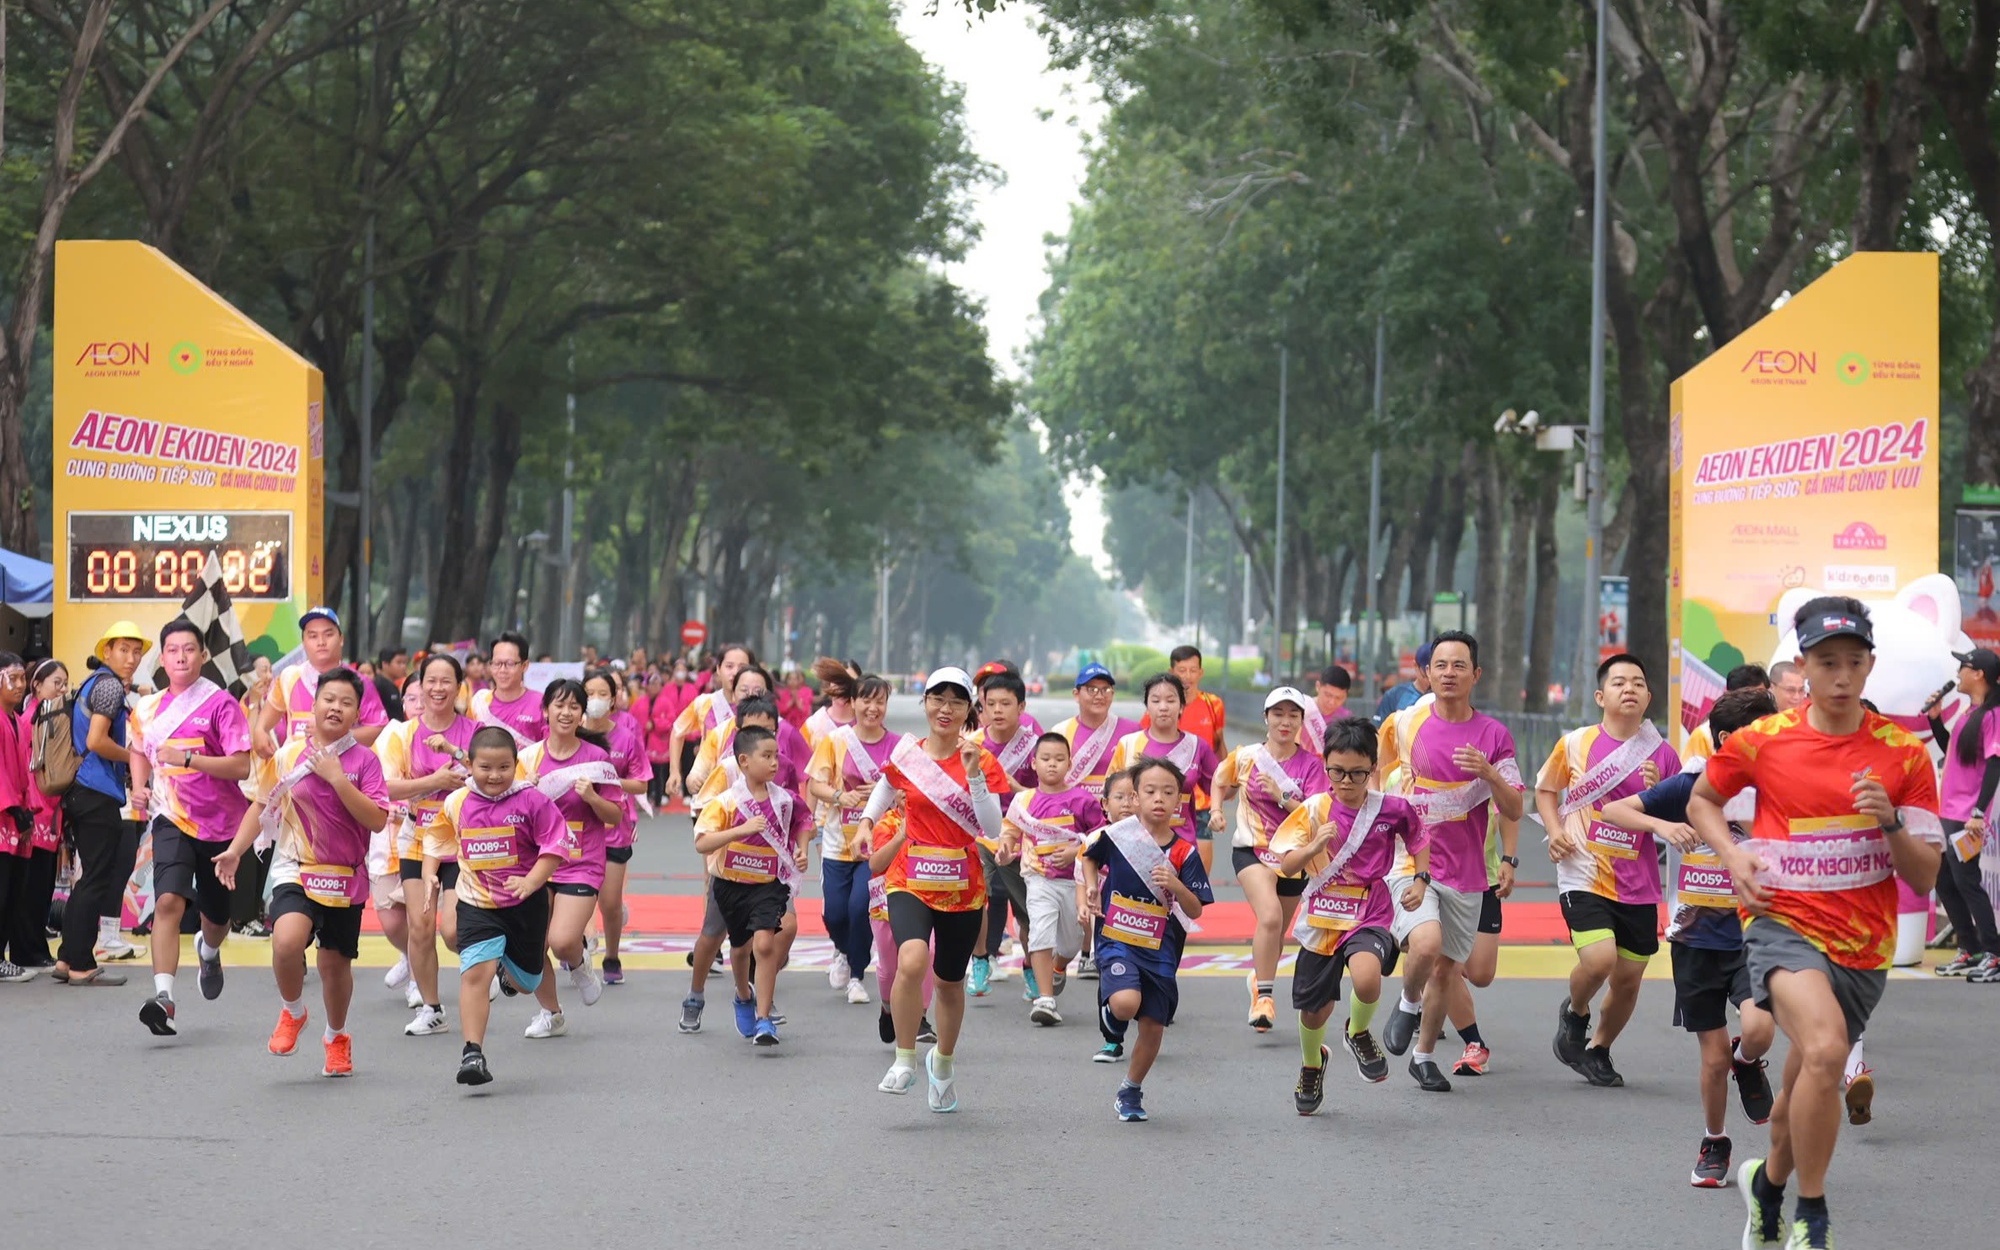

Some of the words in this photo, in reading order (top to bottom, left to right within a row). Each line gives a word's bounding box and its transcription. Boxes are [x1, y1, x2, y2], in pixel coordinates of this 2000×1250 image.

[71, 412, 159, 455] AEON
[160, 426, 245, 466] EKIDEN
[248, 441, 299, 473] 2024
[1695, 450, 1747, 484] AEON
[1749, 435, 1836, 477] EKIDEN
[1839, 419, 1926, 467] 2024
[66, 459, 107, 479] CUNG
[109, 460, 157, 483] ĐƯỜNG
[159, 464, 189, 486] TIẾP
[1892, 466, 1923, 489] VUI
[133, 516, 228, 542] NEXUS
[87, 550, 137, 594] 00
[1571, 778, 1600, 801] EKIDEN
[1597, 762, 1620, 787] 2024
[944, 792, 974, 821] AEON
[466, 840, 510, 853] A0089-1
[1595, 826, 1637, 844] A0028-1
[732, 855, 772, 869] A0026-1
[914, 861, 961, 874] A0022-1
[1780, 855, 1815, 877] 2024
[1817, 853, 1871, 877] EKIDEN
[306, 878, 347, 890] A0098-1
[1313, 897, 1359, 913] A0063-1
[1112, 911, 1160, 931] A0065-1
